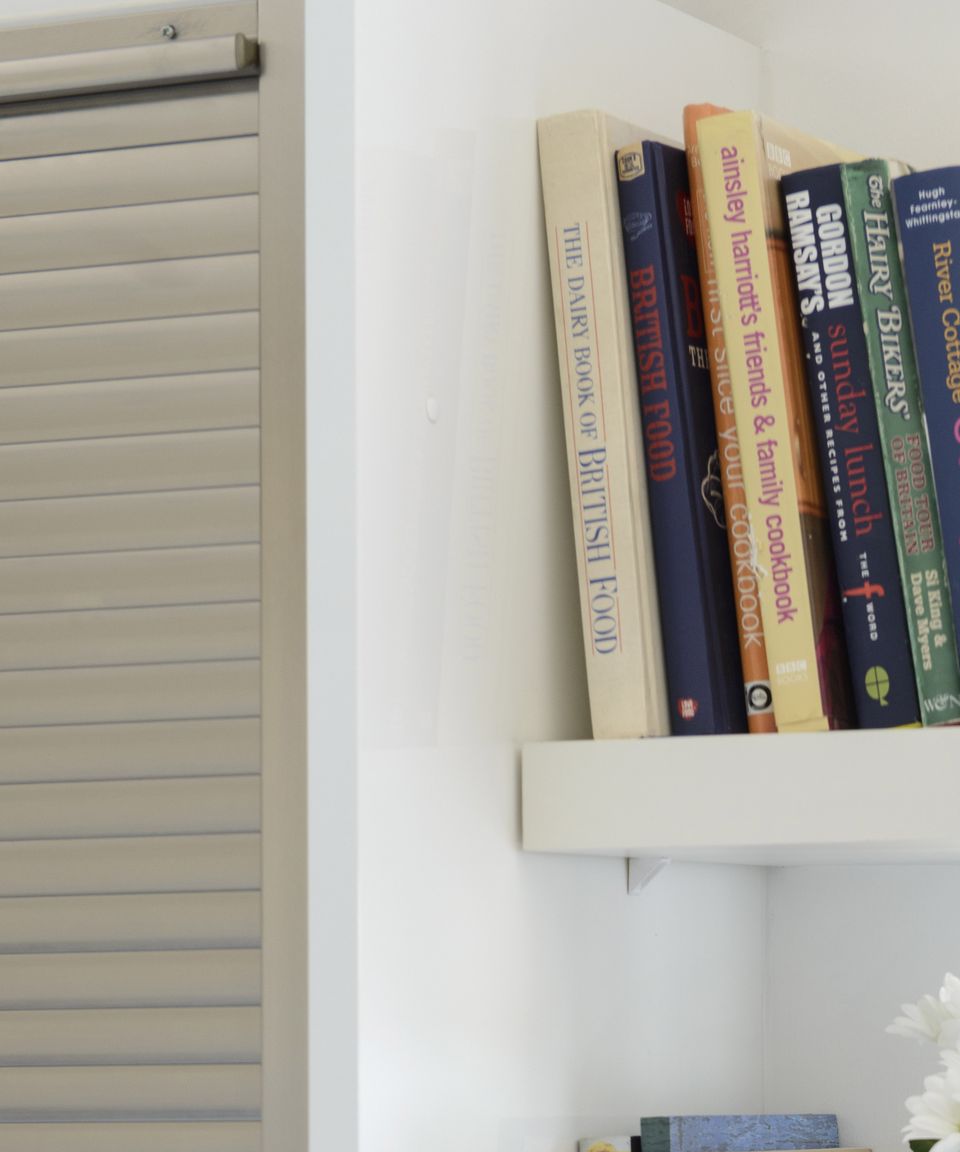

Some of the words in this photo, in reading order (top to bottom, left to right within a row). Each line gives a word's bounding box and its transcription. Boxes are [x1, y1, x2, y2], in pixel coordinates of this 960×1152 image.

[720, 146, 747, 223] ainsley
[918, 186, 945, 202] Hugh
[563, 223, 585, 269] THE
[731, 230, 761, 325] harriott's
[785, 190, 825, 315] RAMSAY'S
[815, 203, 855, 309] GORDON
[864, 210, 897, 301] HAIRY
[933, 240, 952, 303] River
[567, 275, 590, 339] DAIRY
[629, 265, 668, 395] BRITISH
[573, 346, 596, 407] BOOK
[688, 345, 709, 369] TH
[743, 329, 772, 409] friends
[811, 331, 824, 366] AND
[827, 324, 867, 434] sunday
[578, 411, 598, 440] OF
[754, 415, 776, 434] &
[817, 371, 832, 423] OTHER
[644, 402, 677, 483] FOOD
[756, 439, 785, 507] family
[824, 429, 841, 493] RECIPES
[890, 438, 904, 465] OF
[578, 446, 611, 564] BRITISH
[836, 500, 848, 542] FROM
[843, 444, 883, 537] lunch
[895, 470, 919, 556] BRITAIN
[903, 433, 925, 491] FOOD
[914, 494, 934, 552] TOUR
[730, 503, 765, 649] cookbook
[765, 515, 798, 624] cookbook
[843, 581, 885, 598] f
[859, 552, 870, 578] THE
[925, 569, 939, 587] Si
[589, 575, 619, 656] FOOD
[866, 602, 878, 641] WORD
[910, 571, 924, 616] Dave
[917, 618, 932, 671] Myers
[927, 589, 942, 630] King
[934, 634, 947, 648] &
